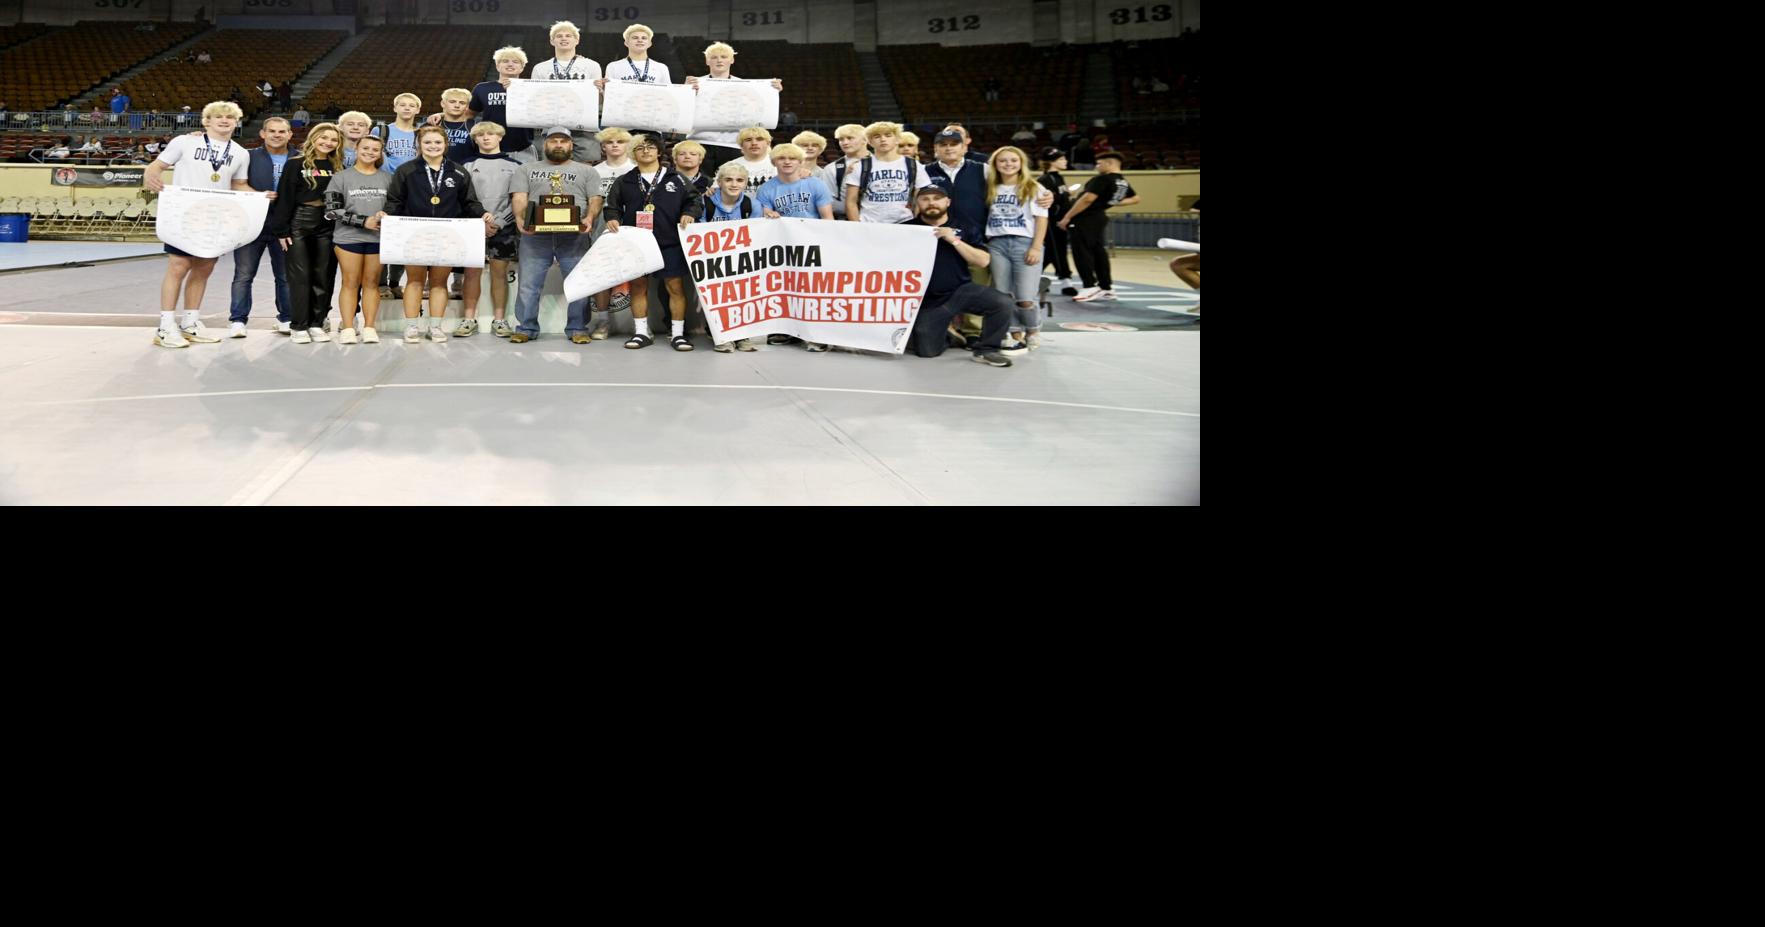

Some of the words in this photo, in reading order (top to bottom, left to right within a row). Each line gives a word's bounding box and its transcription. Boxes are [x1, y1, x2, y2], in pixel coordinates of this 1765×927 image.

[452, 0, 499, 13] 309
[594, 6, 640, 21] 310
[1109, 4, 1173, 26] 313
[742, 11, 785, 26] 311
[928, 15, 981, 33] 312
[774, 191, 812, 209] OUTLAW
[686, 225, 752, 257] 2024
[691, 245, 822, 283] OKLAHOMA
[766, 270, 922, 295] CHAMPIONS
[728, 296, 783, 328] BOYS
[787, 296, 920, 323] WRESTLING
